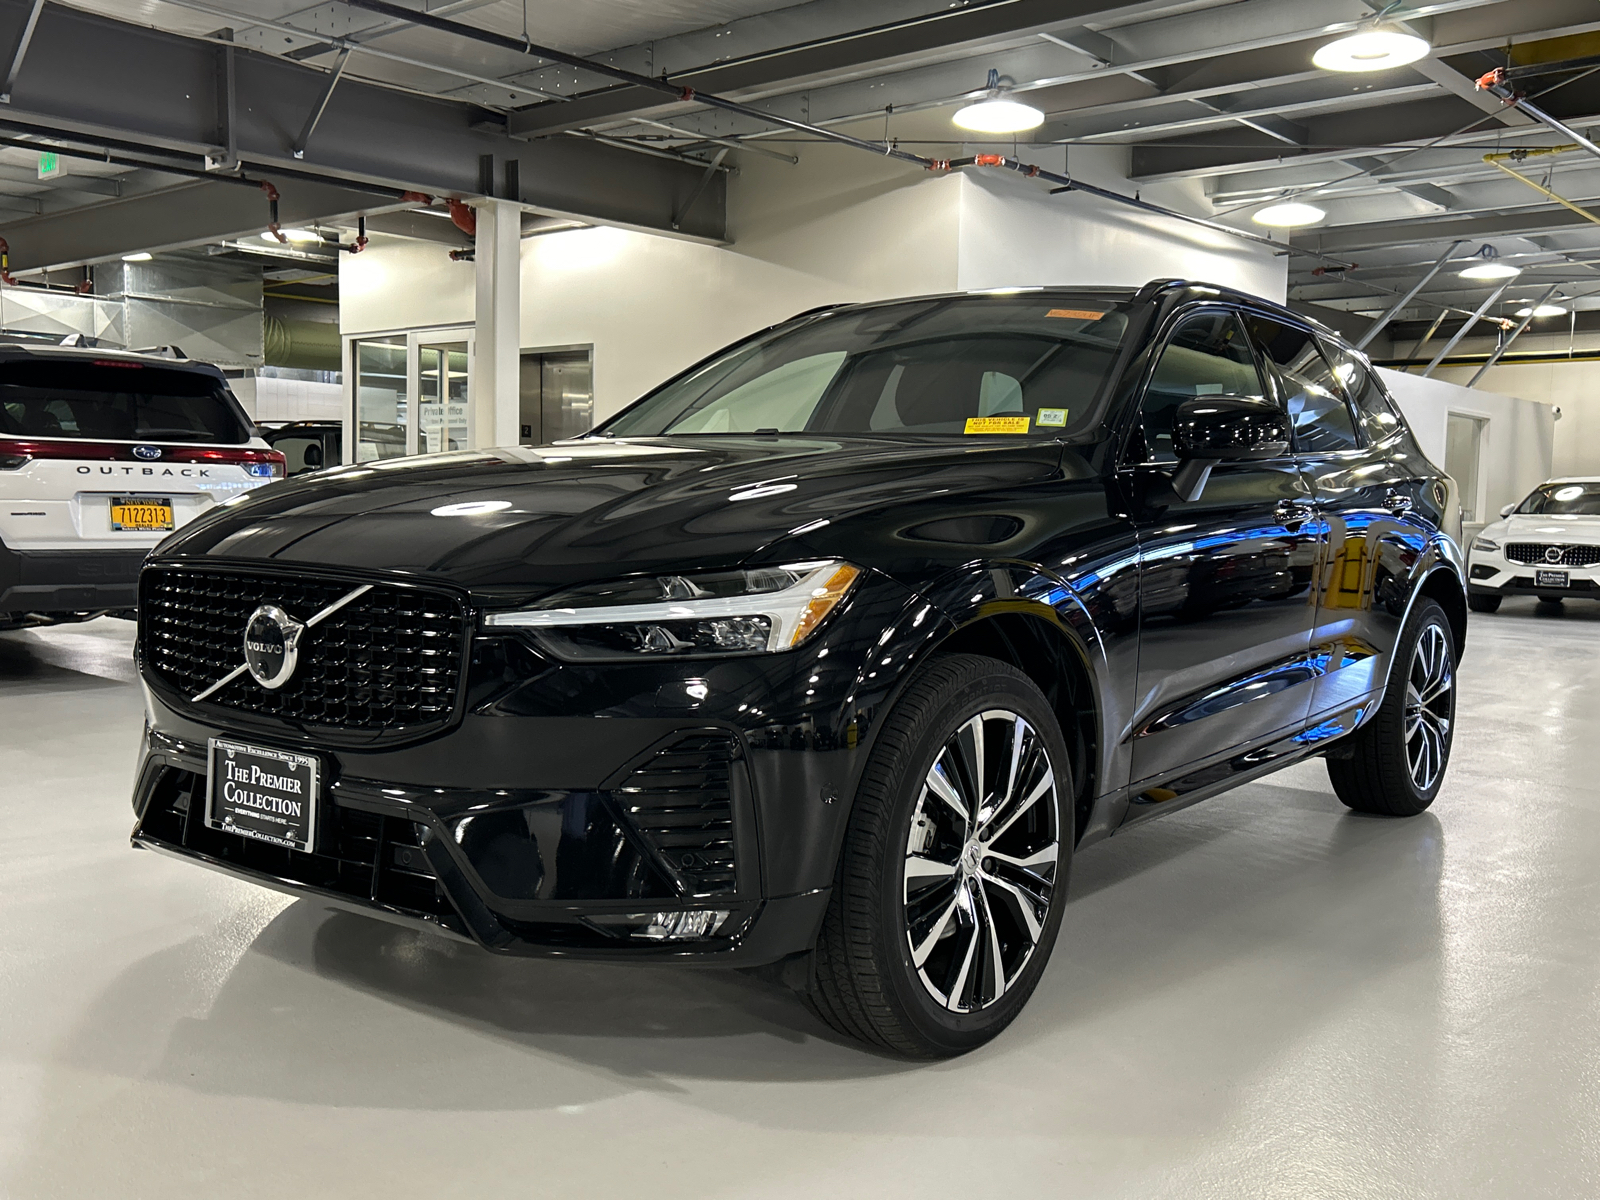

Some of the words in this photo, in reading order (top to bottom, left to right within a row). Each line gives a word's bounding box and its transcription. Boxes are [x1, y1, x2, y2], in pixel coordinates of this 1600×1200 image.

[524, 426, 529, 434] 2
[76, 466, 210, 478] OUTBACK
[119, 507, 166, 524] 7122313
[247, 640, 283, 655] VOLVO
[216, 740, 247, 753] AUTOMOTIVE
[247, 746, 278, 759] EXCELLENCE
[278, 752, 294, 762] SINCE
[224, 759, 249, 783] THE
[250, 764, 302, 794] PREMIER
[223, 781, 302, 817] COLLECTION
[234, 807, 260, 819] EVERYTHING
[260, 813, 275, 822] STARTS
